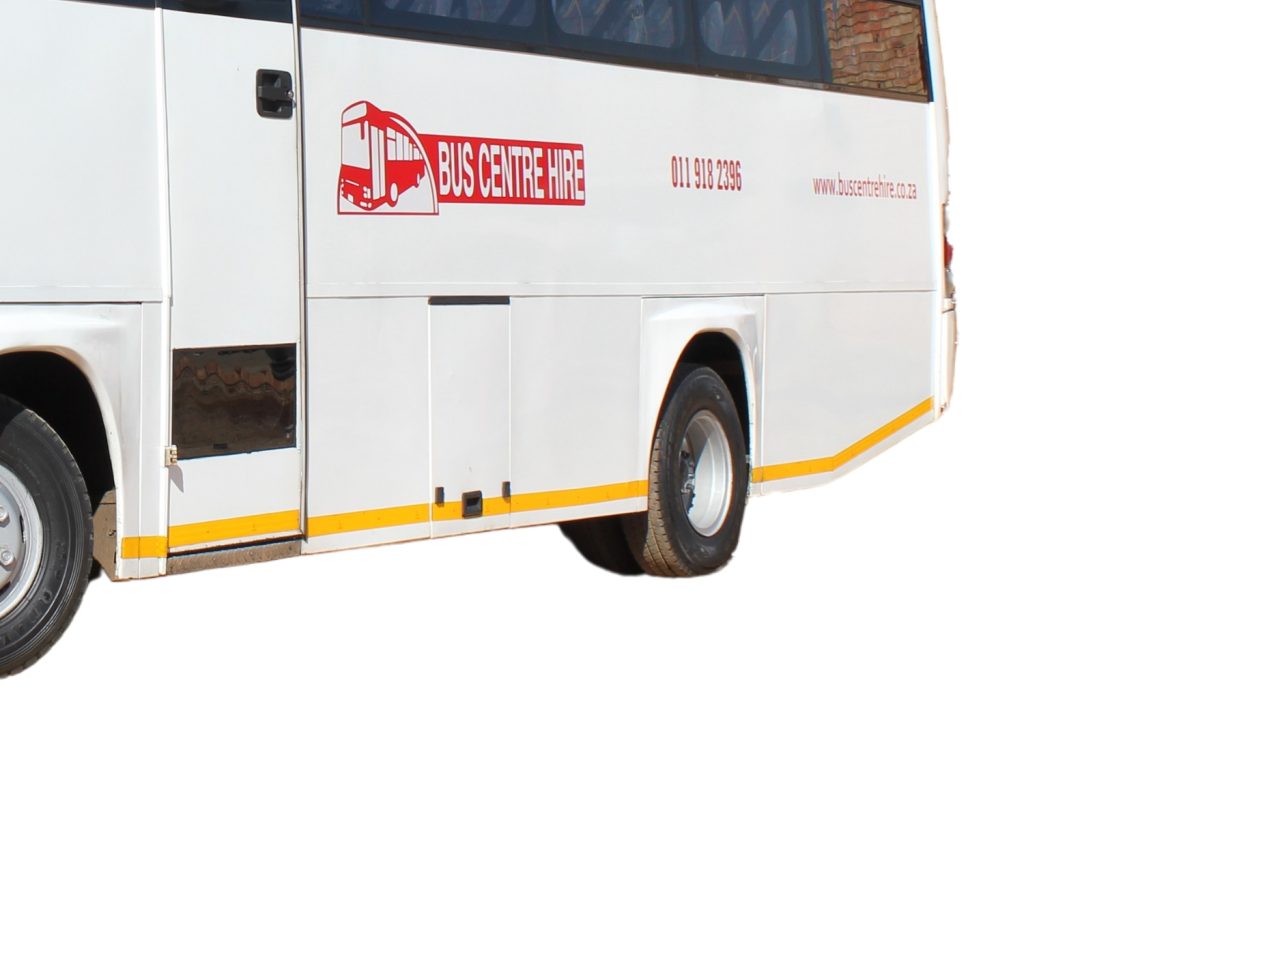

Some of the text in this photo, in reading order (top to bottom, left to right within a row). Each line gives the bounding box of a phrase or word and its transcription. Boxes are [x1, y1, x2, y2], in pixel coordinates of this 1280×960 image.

[437, 141, 585, 200] BUS CENTRE HIRE
[671, 155, 742, 191] 011 918 2396
[812, 171, 918, 200] www.buscentrehire.co.za
